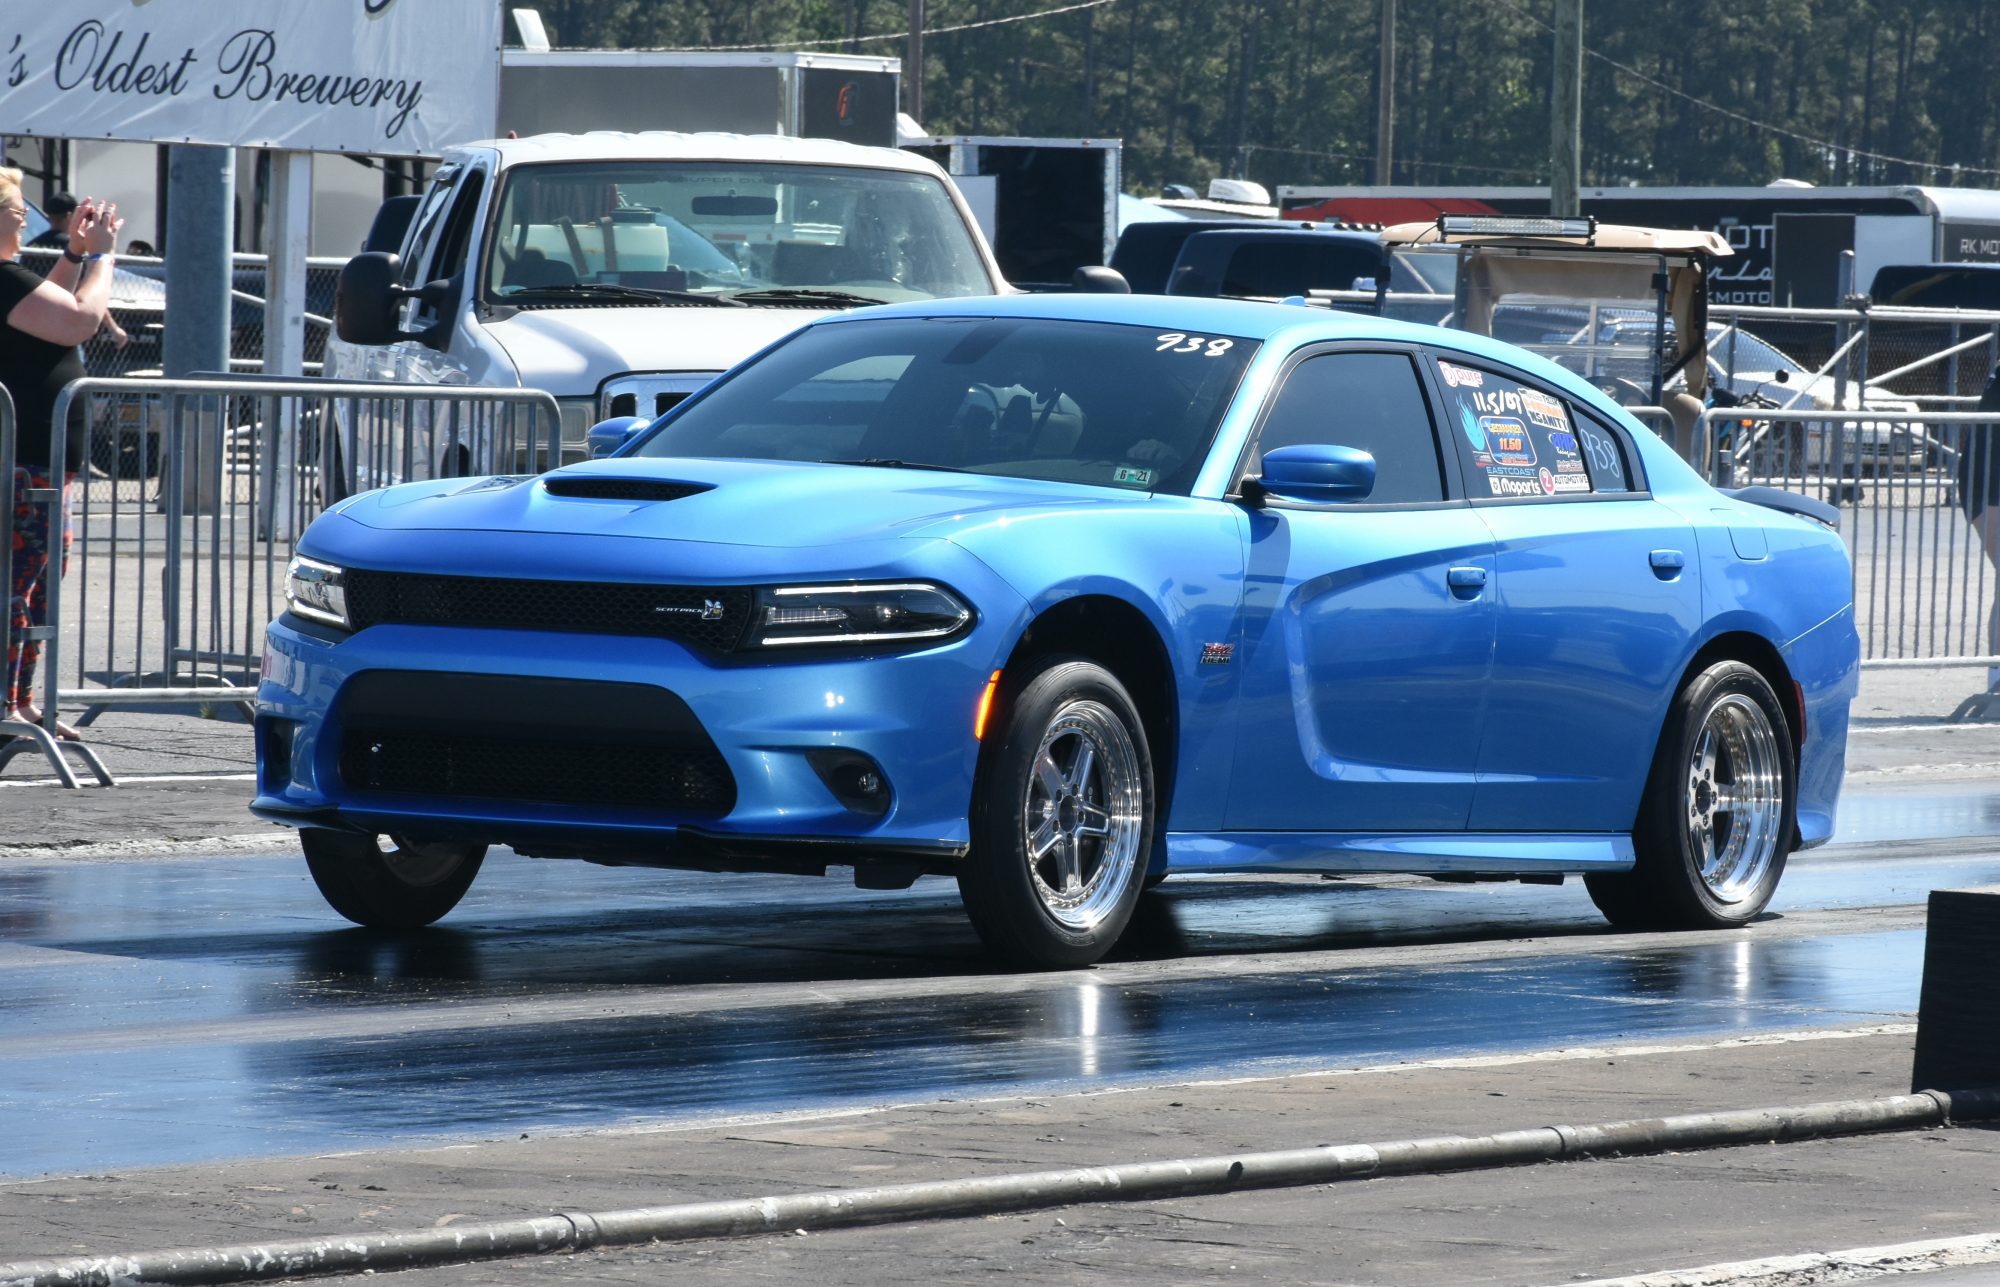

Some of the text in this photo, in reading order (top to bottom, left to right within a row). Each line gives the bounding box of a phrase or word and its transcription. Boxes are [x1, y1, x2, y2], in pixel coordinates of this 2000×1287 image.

[55, 19, 197, 95] Oldest
[213, 29, 423, 138] Brewery
[1960, 238, 2000, 255] RK MO
[1156, 333, 1234, 356] 938
[1581, 428, 1620, 478] 938
[1501, 477, 1541, 495] Moparts
